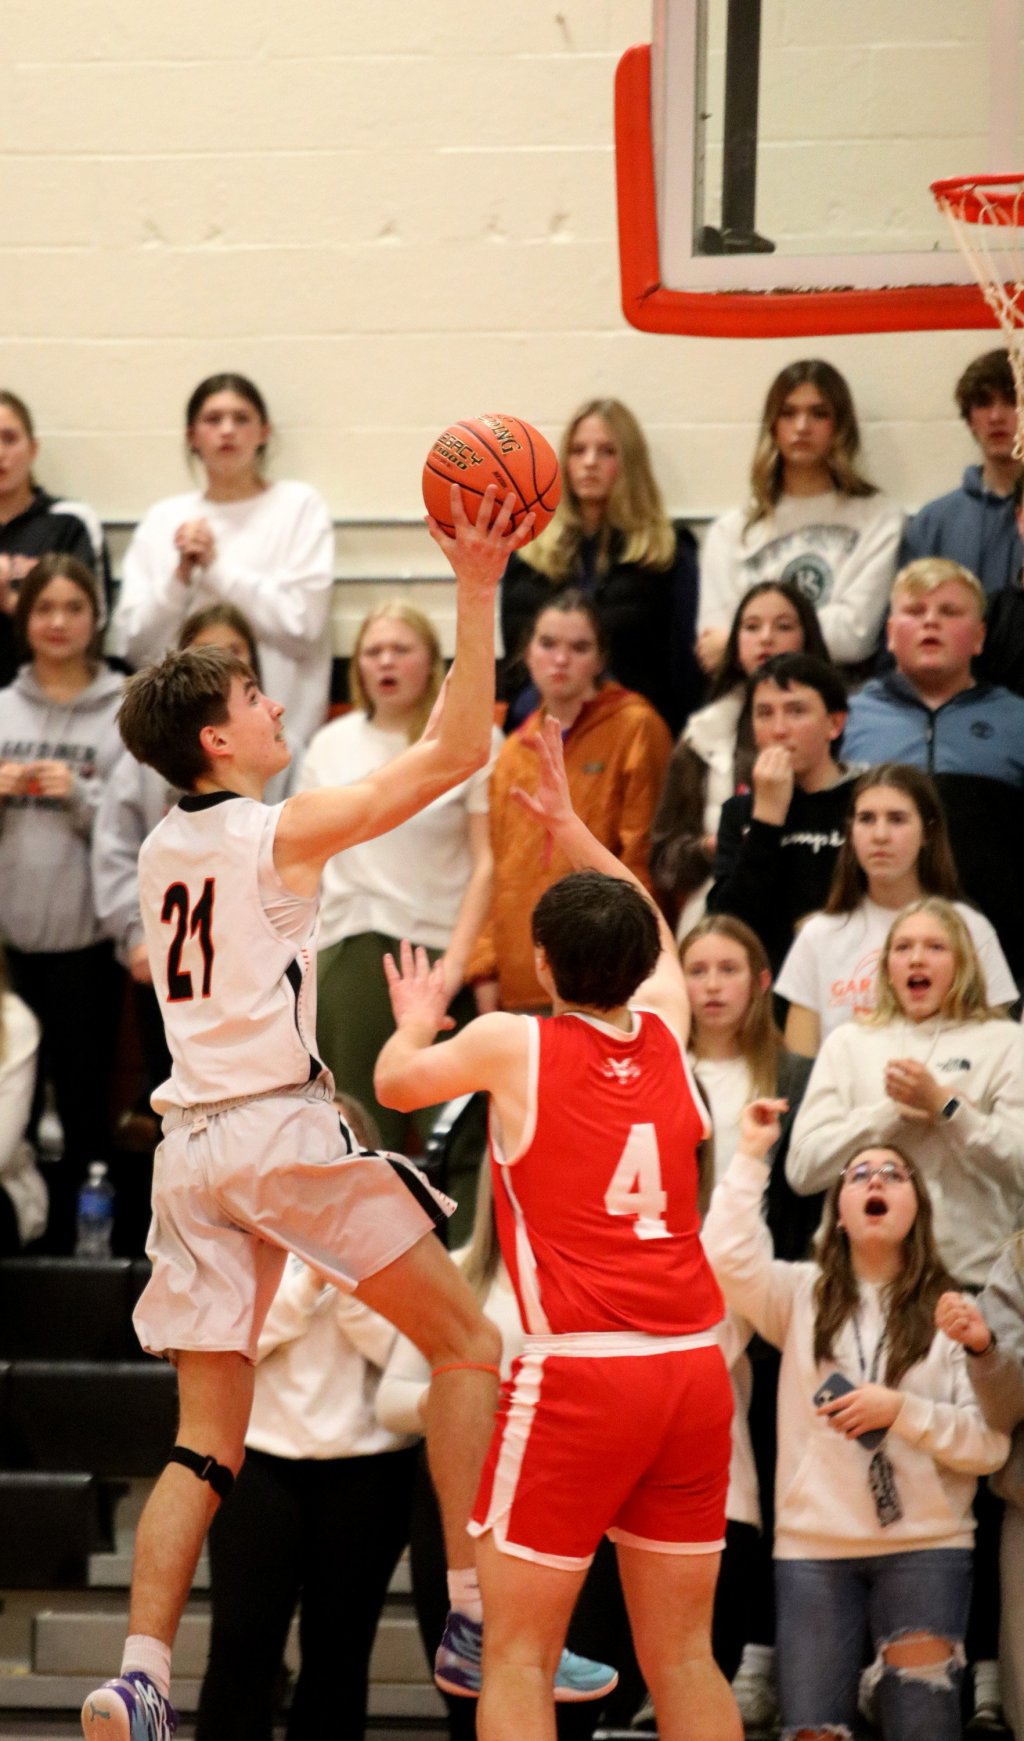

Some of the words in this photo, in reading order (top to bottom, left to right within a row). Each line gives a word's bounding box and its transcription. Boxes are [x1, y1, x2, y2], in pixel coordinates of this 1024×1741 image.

[438, 432, 485, 466] EGACY
[161, 877, 215, 1003] 21
[604, 1122, 674, 1240] 4
